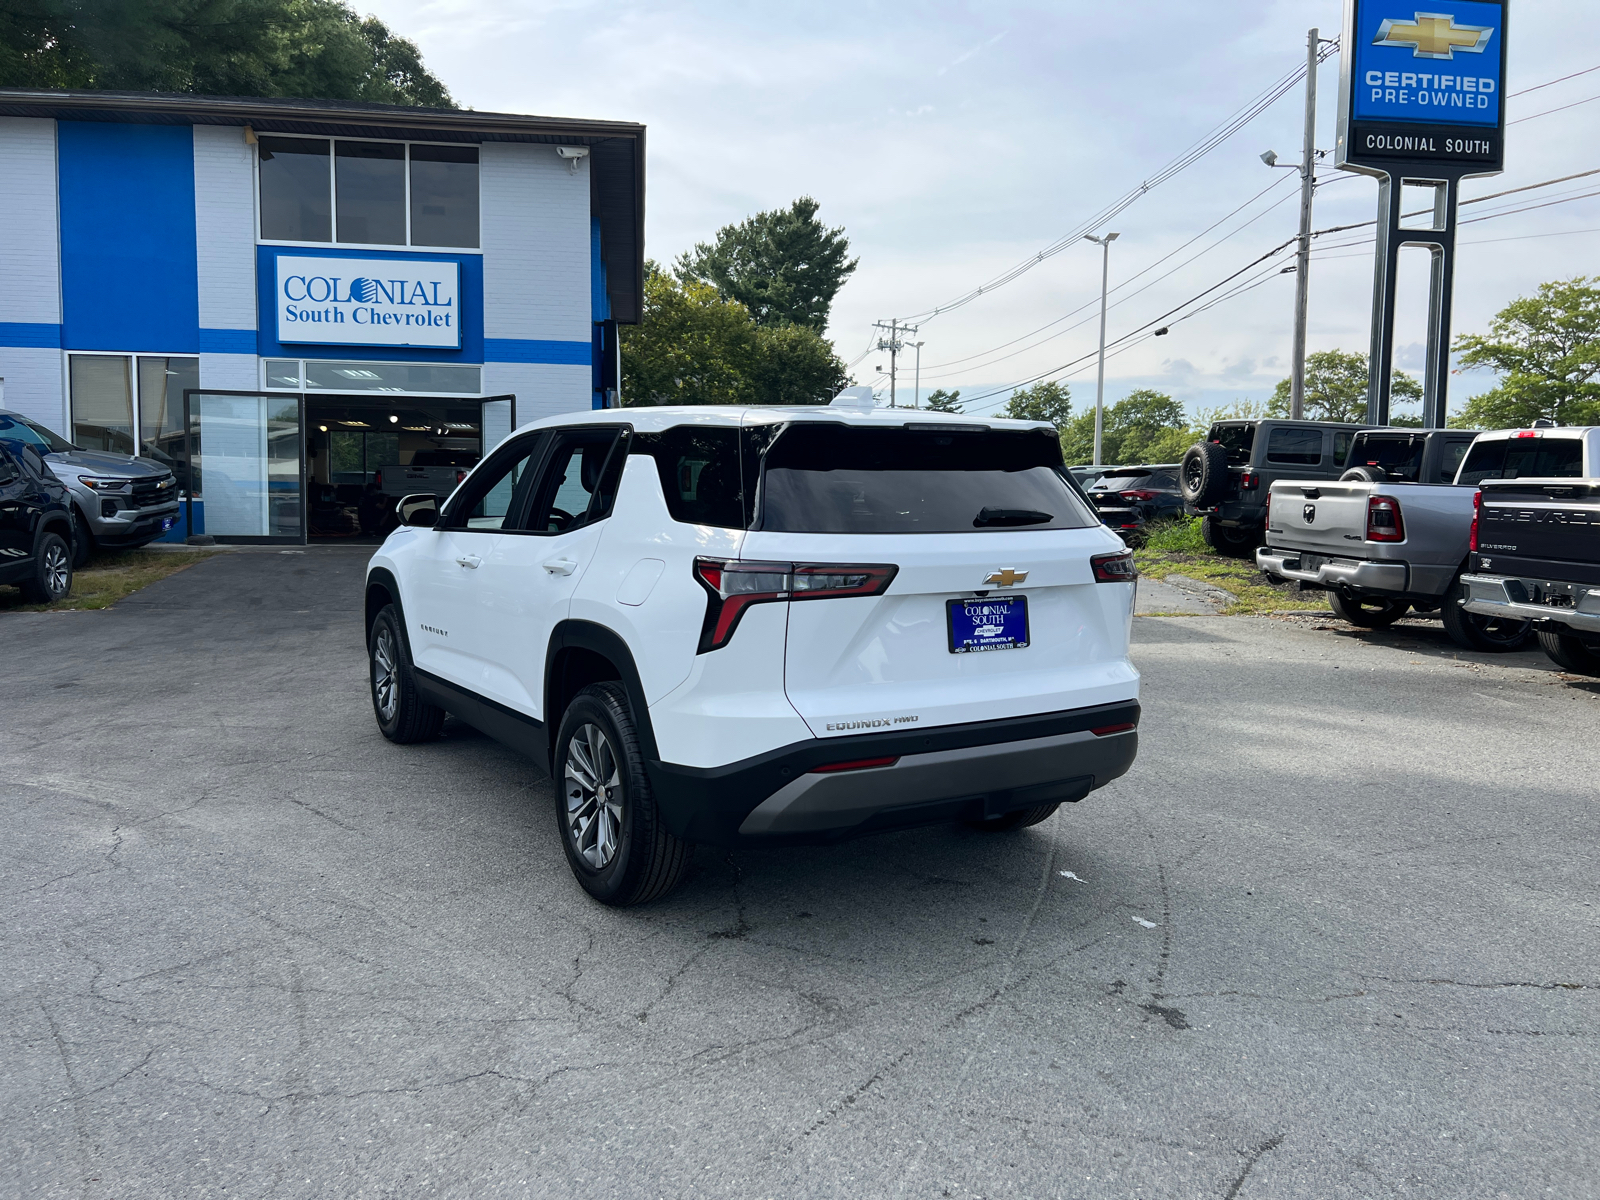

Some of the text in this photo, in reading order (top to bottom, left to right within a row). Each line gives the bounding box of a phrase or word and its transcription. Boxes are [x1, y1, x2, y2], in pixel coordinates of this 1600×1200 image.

[1365, 70, 1495, 93] CERTIFIED
[1371, 88, 1488, 109] PRE-OWNED
[1366, 134, 1490, 154] COLONIAL SOUTH
[284, 275, 452, 306] COLONIAL
[286, 304, 452, 327] South Chevrolet
[1480, 543, 1517, 551] SILVERADO
[965, 605, 1011, 616] COLONIAL
[972, 614, 1004, 625] SOUTH
[969, 644, 995, 652] COLONIAL
[826, 715, 919, 731] EQUINOX AWD
